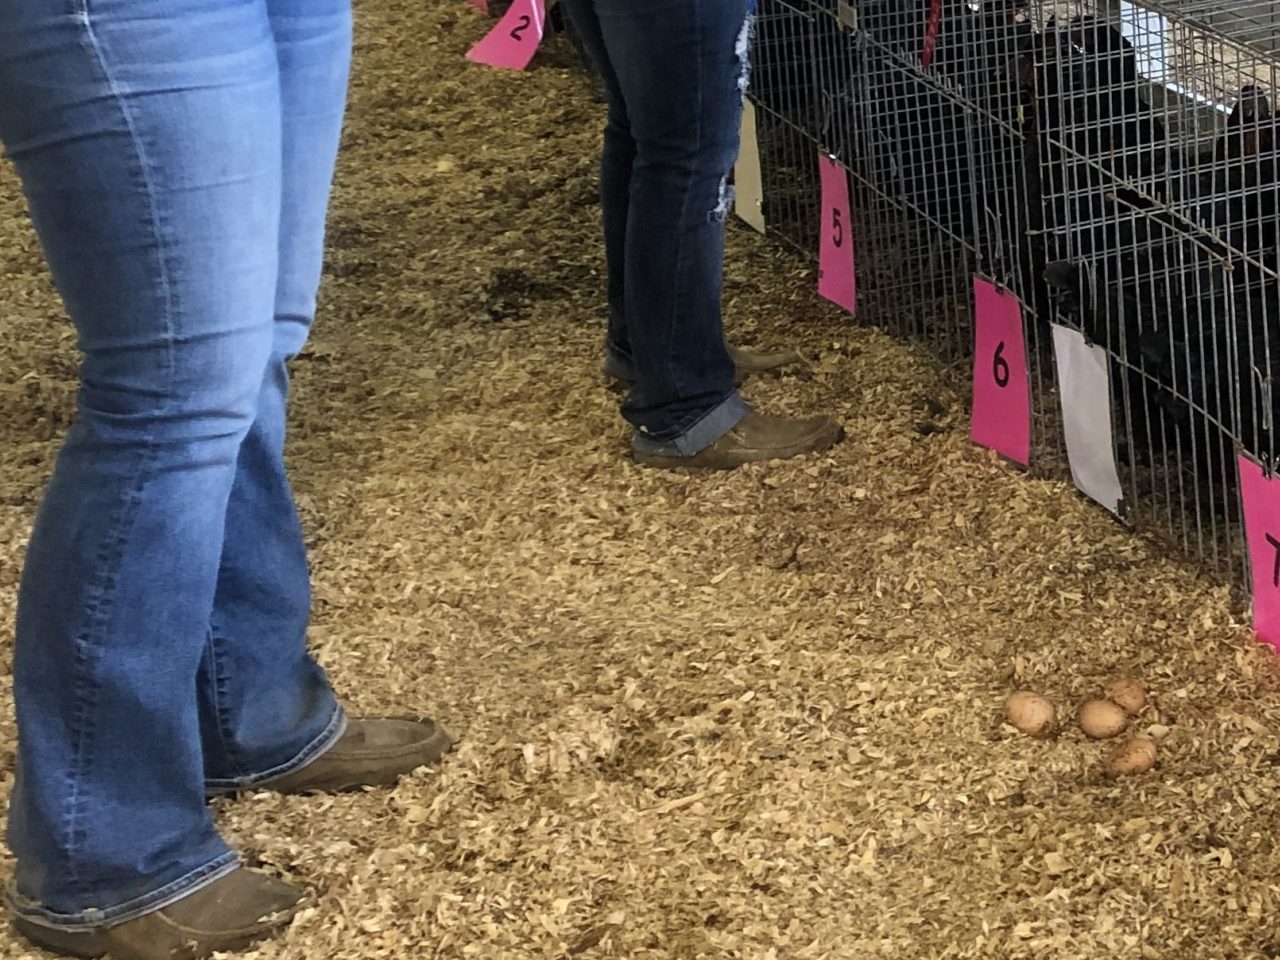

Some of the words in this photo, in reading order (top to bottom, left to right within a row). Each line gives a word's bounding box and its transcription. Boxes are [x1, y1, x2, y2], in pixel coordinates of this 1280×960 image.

[510, 15, 531, 42] 2
[832, 208, 843, 248] 5
[993, 341, 1010, 388] 6
